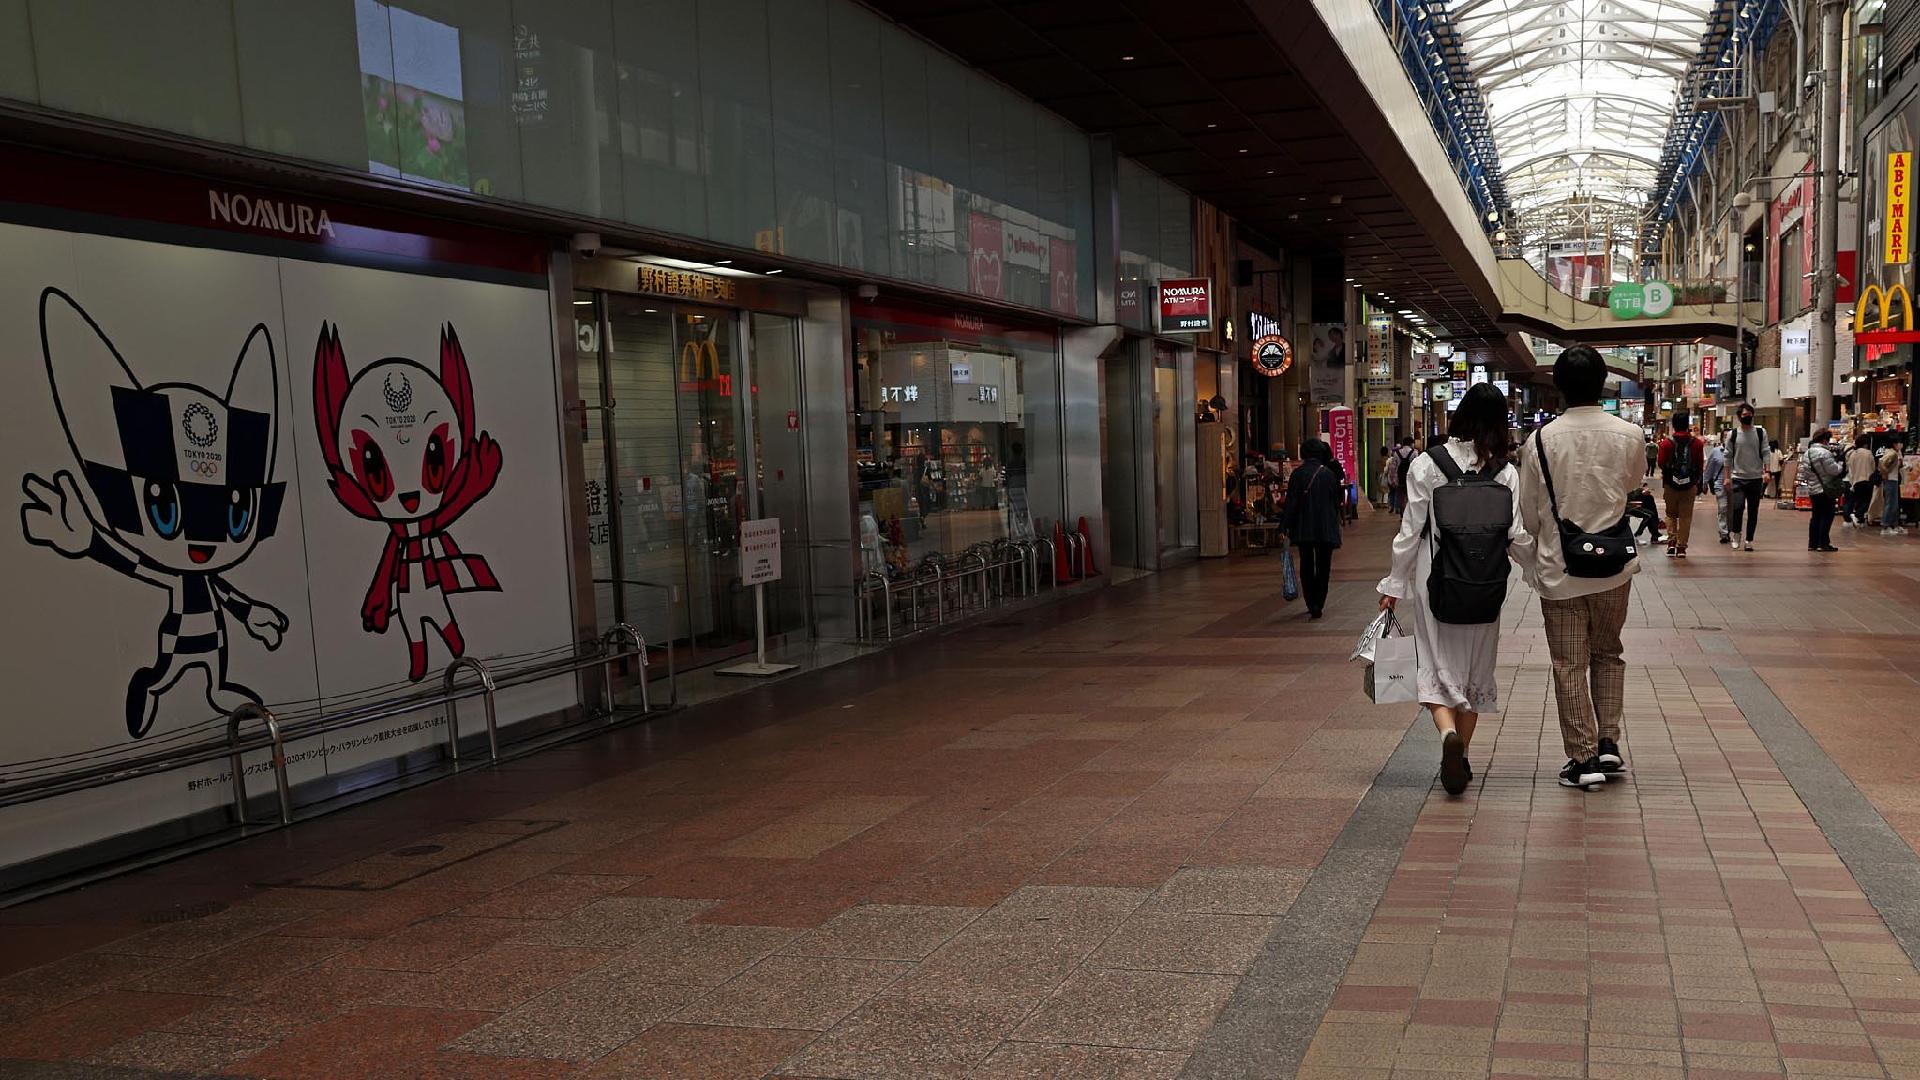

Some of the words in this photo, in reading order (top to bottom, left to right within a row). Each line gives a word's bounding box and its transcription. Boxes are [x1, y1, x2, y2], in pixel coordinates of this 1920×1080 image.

[209, 190, 335, 238] NOMURA
[1163, 287, 1205, 296] NOMURA
[953, 312, 984, 331] NOMURA
[184, 450, 206, 458] TOKYO
[206, 452, 222, 461] 2020
